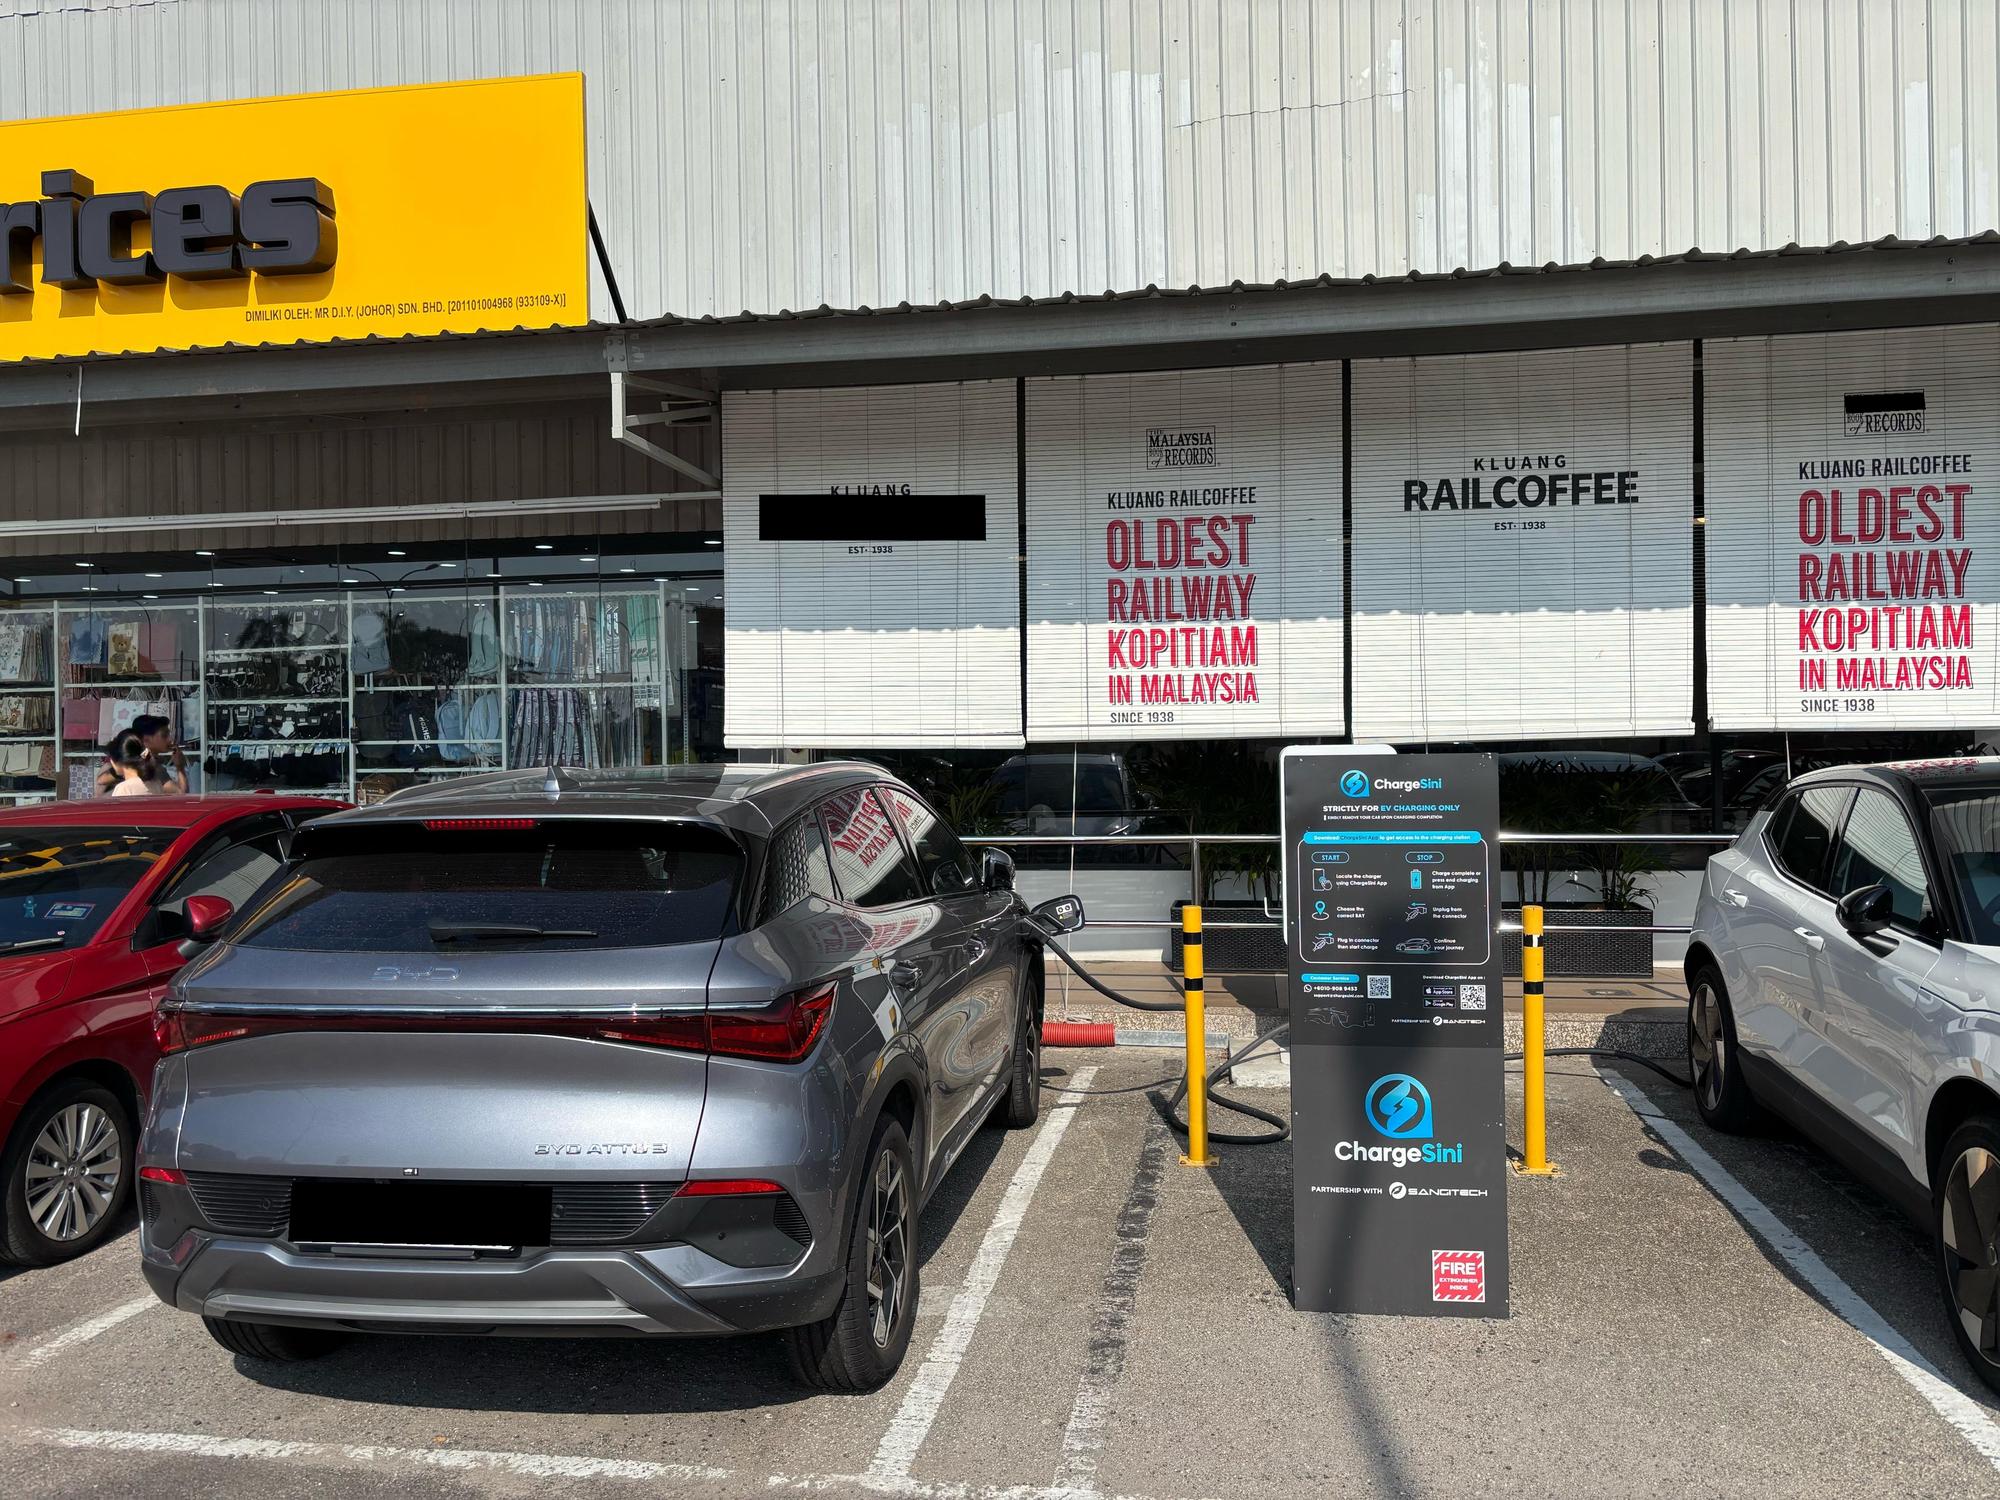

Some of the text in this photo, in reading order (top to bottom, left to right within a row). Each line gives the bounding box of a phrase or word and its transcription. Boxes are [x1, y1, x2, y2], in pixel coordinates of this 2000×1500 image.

[245, 292, 567, 322] DIMILIKI OLEH: MR D.I.Y. (JOHOR) SDN. BHD. [201101004968 (933109-X)]
[1865, 412, 1922, 433] RECORDS
[1149, 431, 1214, 448] MALAYSIA
[1164, 447, 1214, 467] RECORDS
[1474, 454, 1566, 472] KLUANG
[1799, 454, 1972, 480] KLUANG RAILCOFFEE
[1108, 486, 1257, 509] KLUANG RAILCOFFEE
[1403, 471, 1639, 512] RAILCOFFEE
[1521, 520, 1546, 530] 1938
[1799, 484, 1973, 545] OLDEST
[871, 544, 893, 554] 1938
[1106, 513, 1256, 571] OLDEST
[1799, 548, 1973, 602] RAILWAY
[1107, 573, 1257, 623] RAILWAY
[1799, 604, 1974, 652] KOPITIAM
[1108, 625, 1258, 669] KOPITIAM
[1799, 655, 1974, 692] IN MALAYSIA
[1108, 671, 1259, 705] IN MALAYSIA
[1801, 698, 1875, 712] SINCE 1938
[1110, 711, 1174, 724] SINCE 1938
[1374, 777, 1442, 792] ChargeSini
[1393, 804, 1436, 812] CHARGING
[368, 965, 462, 981] BYD
[534, 1143, 582, 1155] BYD
[1334, 1140, 1463, 1168] ChargeSini
[1311, 1186, 1361, 1194] PARTNERSHIP
[1440, 1262, 1477, 1275] FIRE
